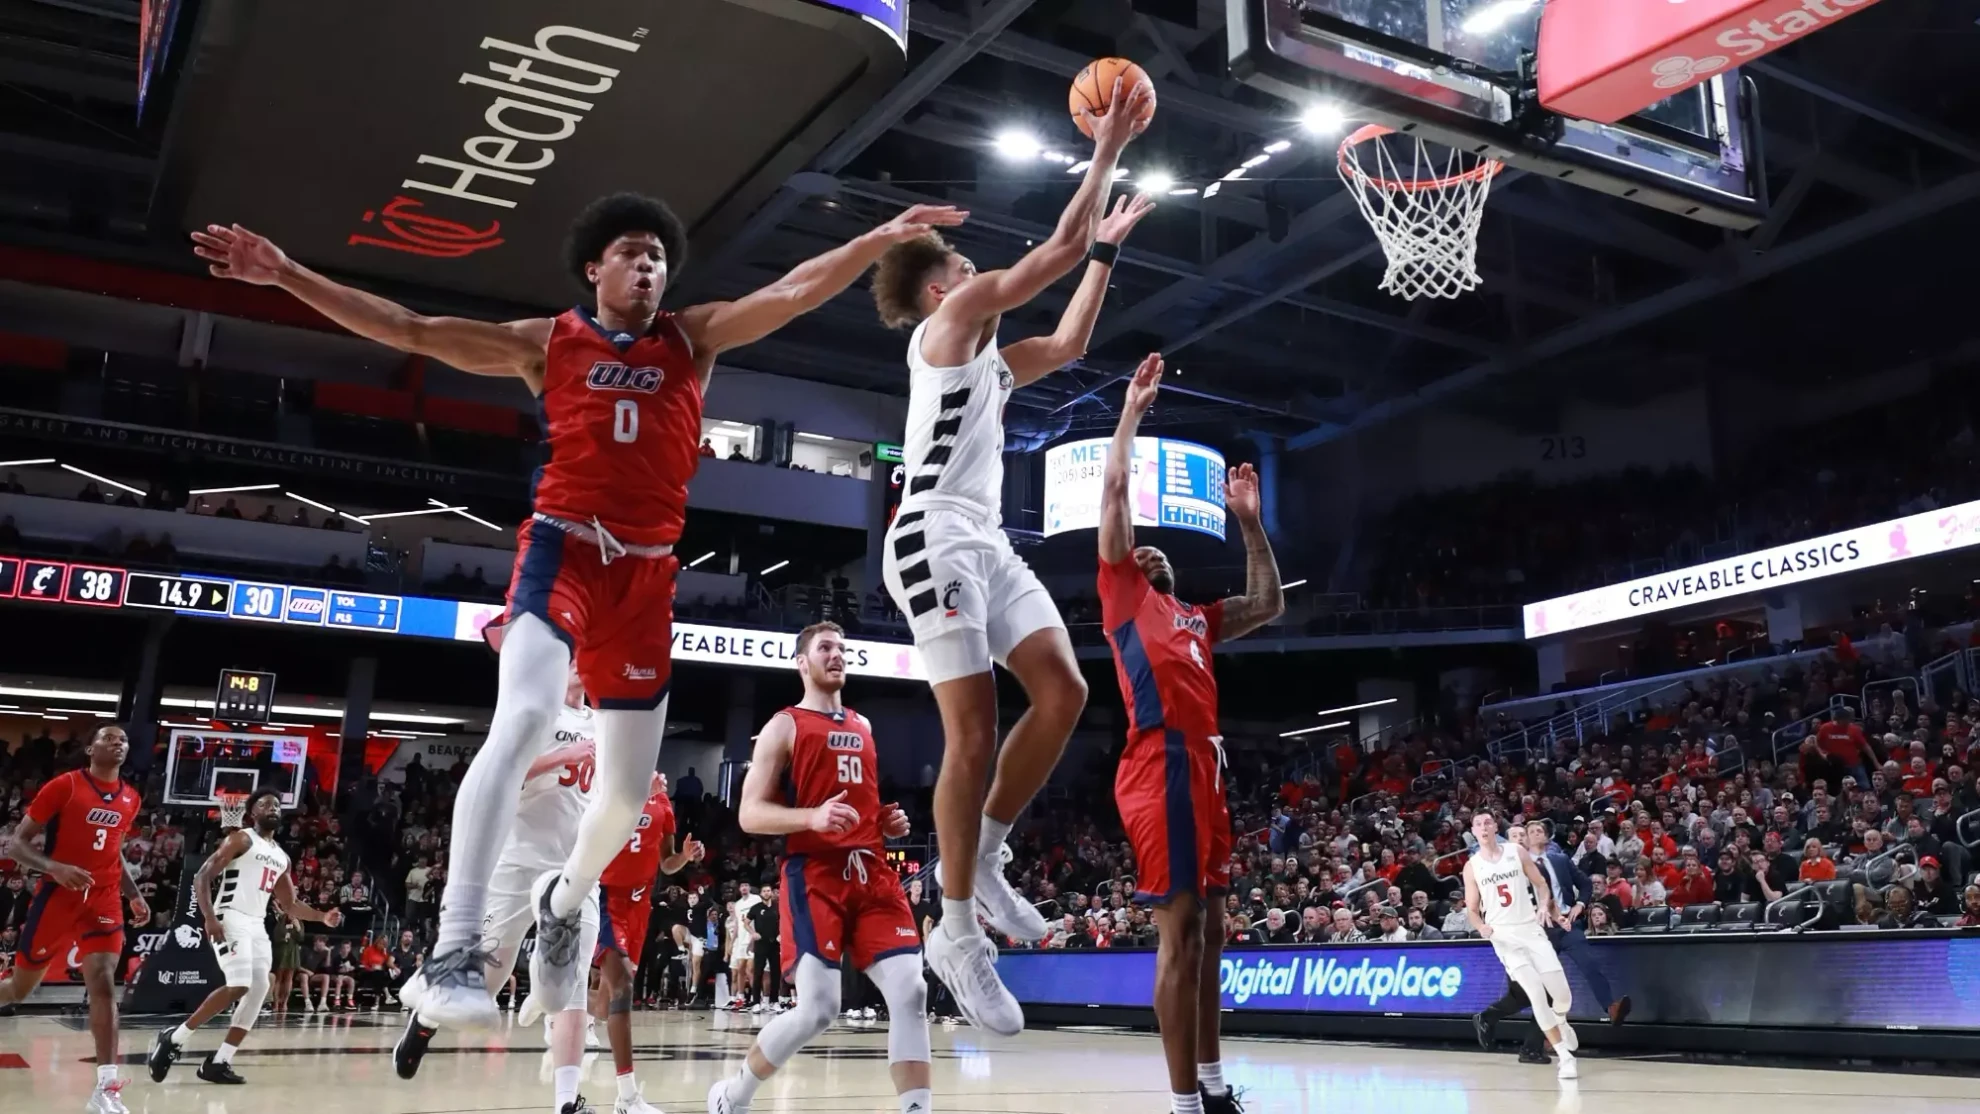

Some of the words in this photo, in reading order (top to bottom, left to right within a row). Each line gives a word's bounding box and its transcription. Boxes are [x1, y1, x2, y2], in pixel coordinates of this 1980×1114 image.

[401, 25, 641, 209] Health
[586, 361, 664, 394] UIC
[613, 399, 639, 443] 0
[83, 427, 129, 441] AND
[143, 434, 238, 456] MICHAEL
[251, 447, 364, 473] VALENTINE
[376, 465, 458, 484] INCLINE
[1071, 443, 1143, 464] METL
[1540, 436, 1586, 461] 213
[80, 571, 113, 600] 38
[1628, 563, 1745, 607] CRAVEABLE
[1750, 540, 1860, 580] CLASSICS
[159, 580, 202, 607] 14.9
[244, 587, 274, 615] 30
[336, 596, 356, 607] TOL
[379, 600, 387, 611] 3
[378, 614, 385, 625] 7
[761, 640, 868, 666] CLACS
[230, 676, 259, 691] 14.8
[622, 663, 657, 679] Flames
[828, 731, 864, 752] UIC
[837, 755, 863, 784] 50
[86, 808, 122, 828] UIC
[93, 829, 107, 851] 3
[260, 866, 277, 893] 15
[1481, 870, 1519, 886] CINCINNATI
[1497, 883, 1513, 908] 5
[1220, 956, 1299, 1004] Digital
[1303, 956, 1462, 1006] Workplace
